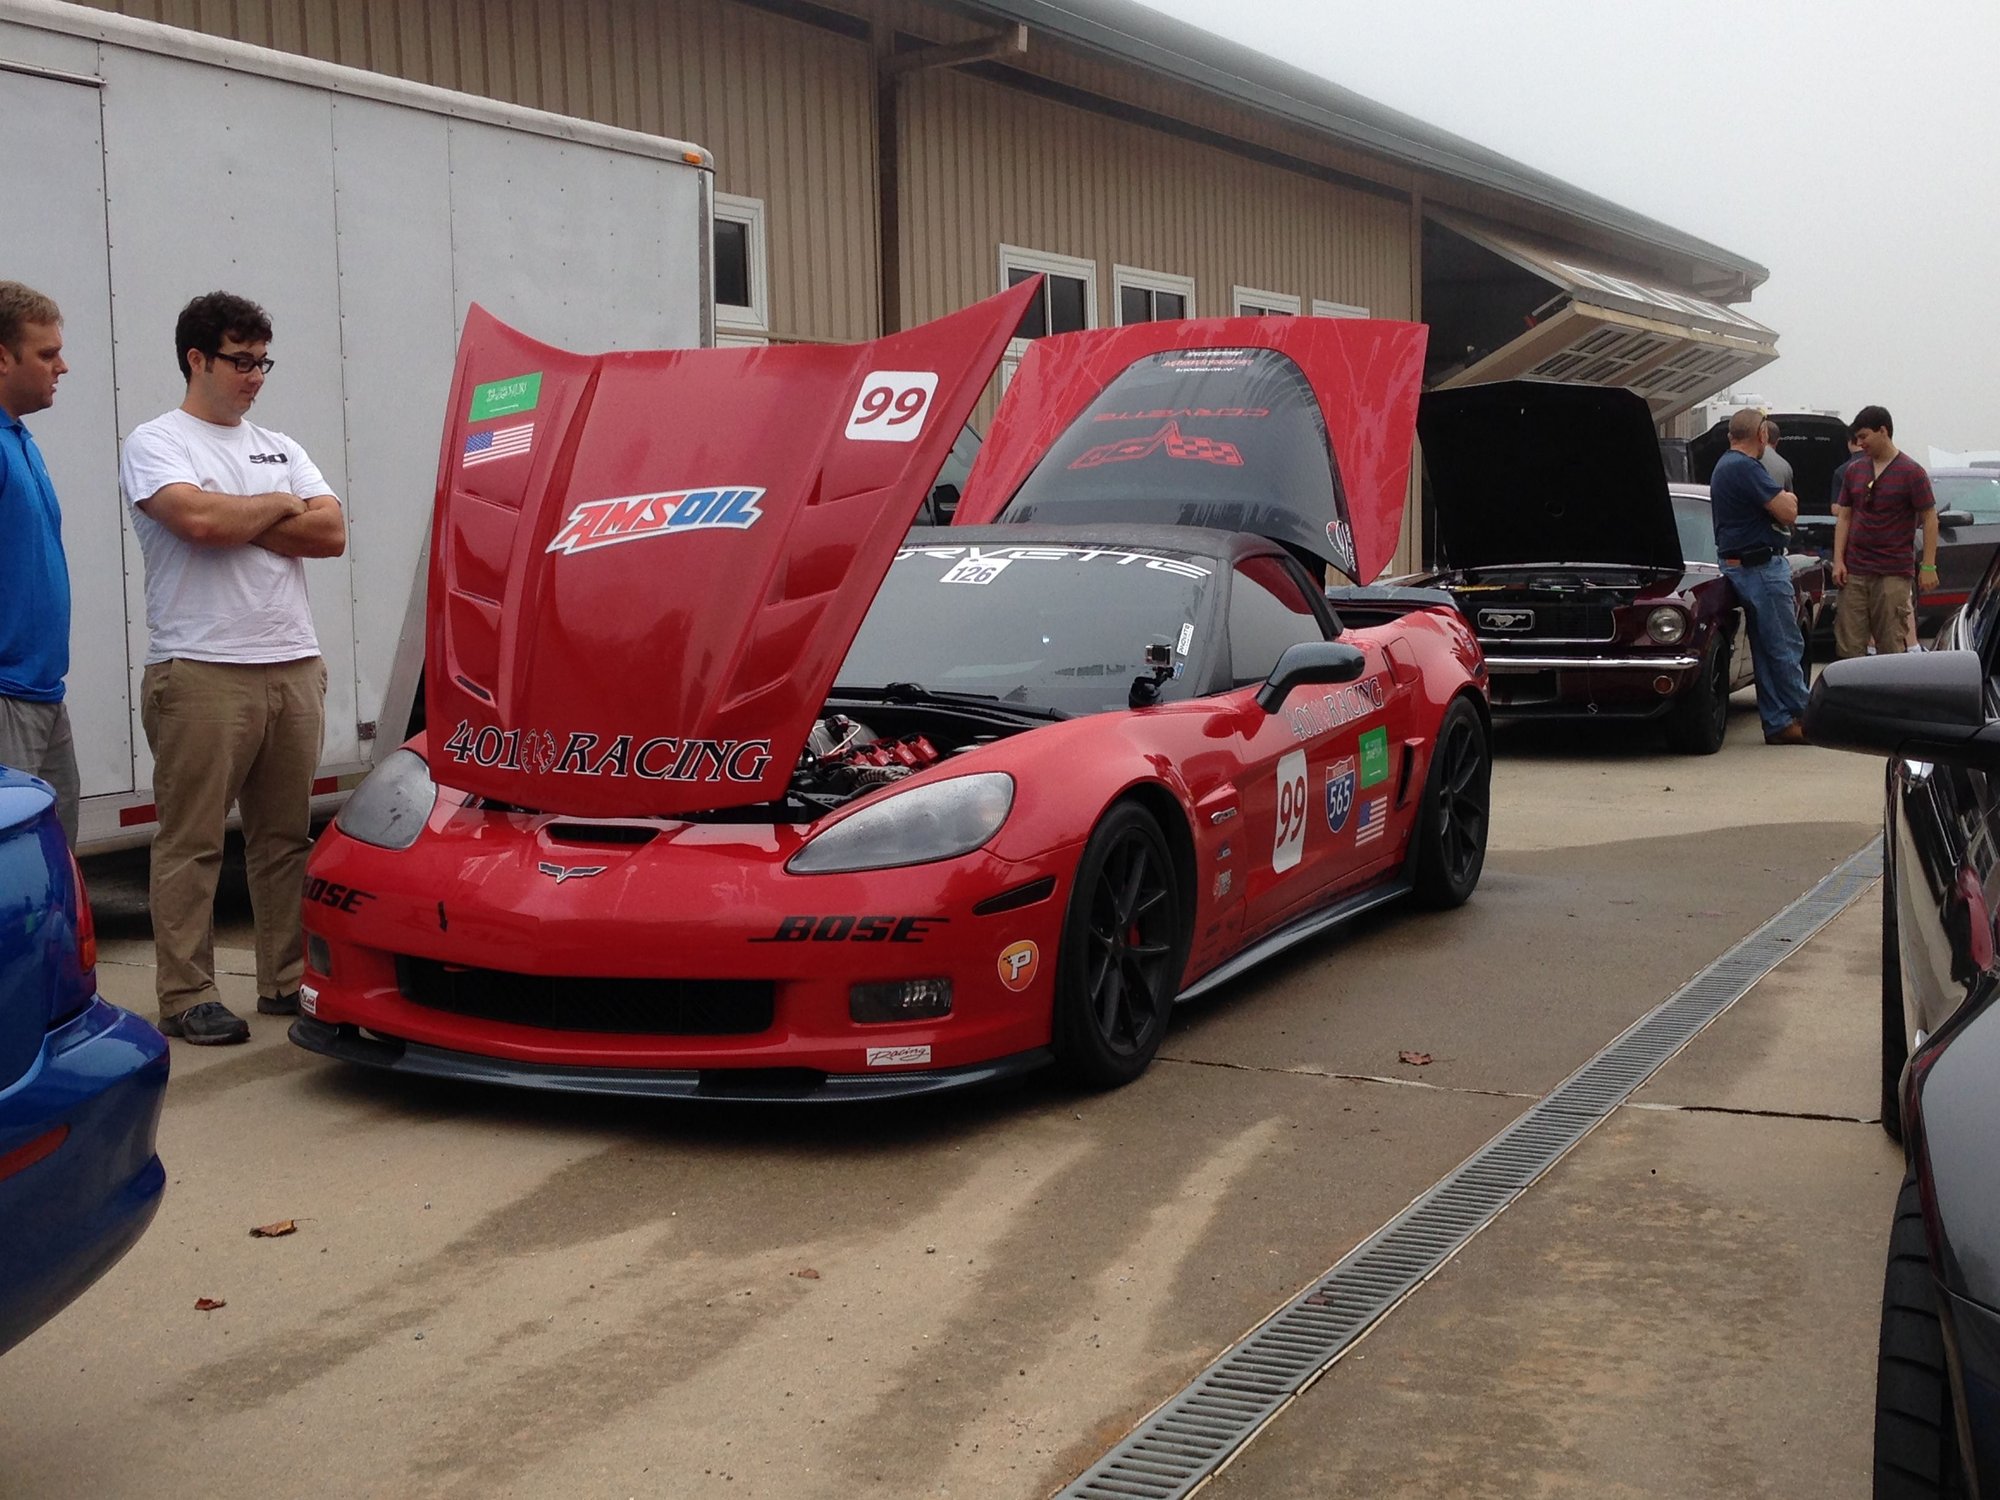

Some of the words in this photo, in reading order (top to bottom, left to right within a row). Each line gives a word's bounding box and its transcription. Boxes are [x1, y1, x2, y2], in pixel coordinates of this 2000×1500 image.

[854, 386, 927, 425] 99
[554, 488, 761, 550] AMSOIL
[894, 547, 1212, 579] RVETTE
[951, 566, 997, 582] 126
[1323, 677, 1385, 728] RACING
[552, 732, 773, 782] RACING
[1277, 775, 1306, 848] 99
[1329, 779, 1350, 819] 565
[747, 916, 949, 943] BOSE
[869, 1047, 929, 1065] Racing
